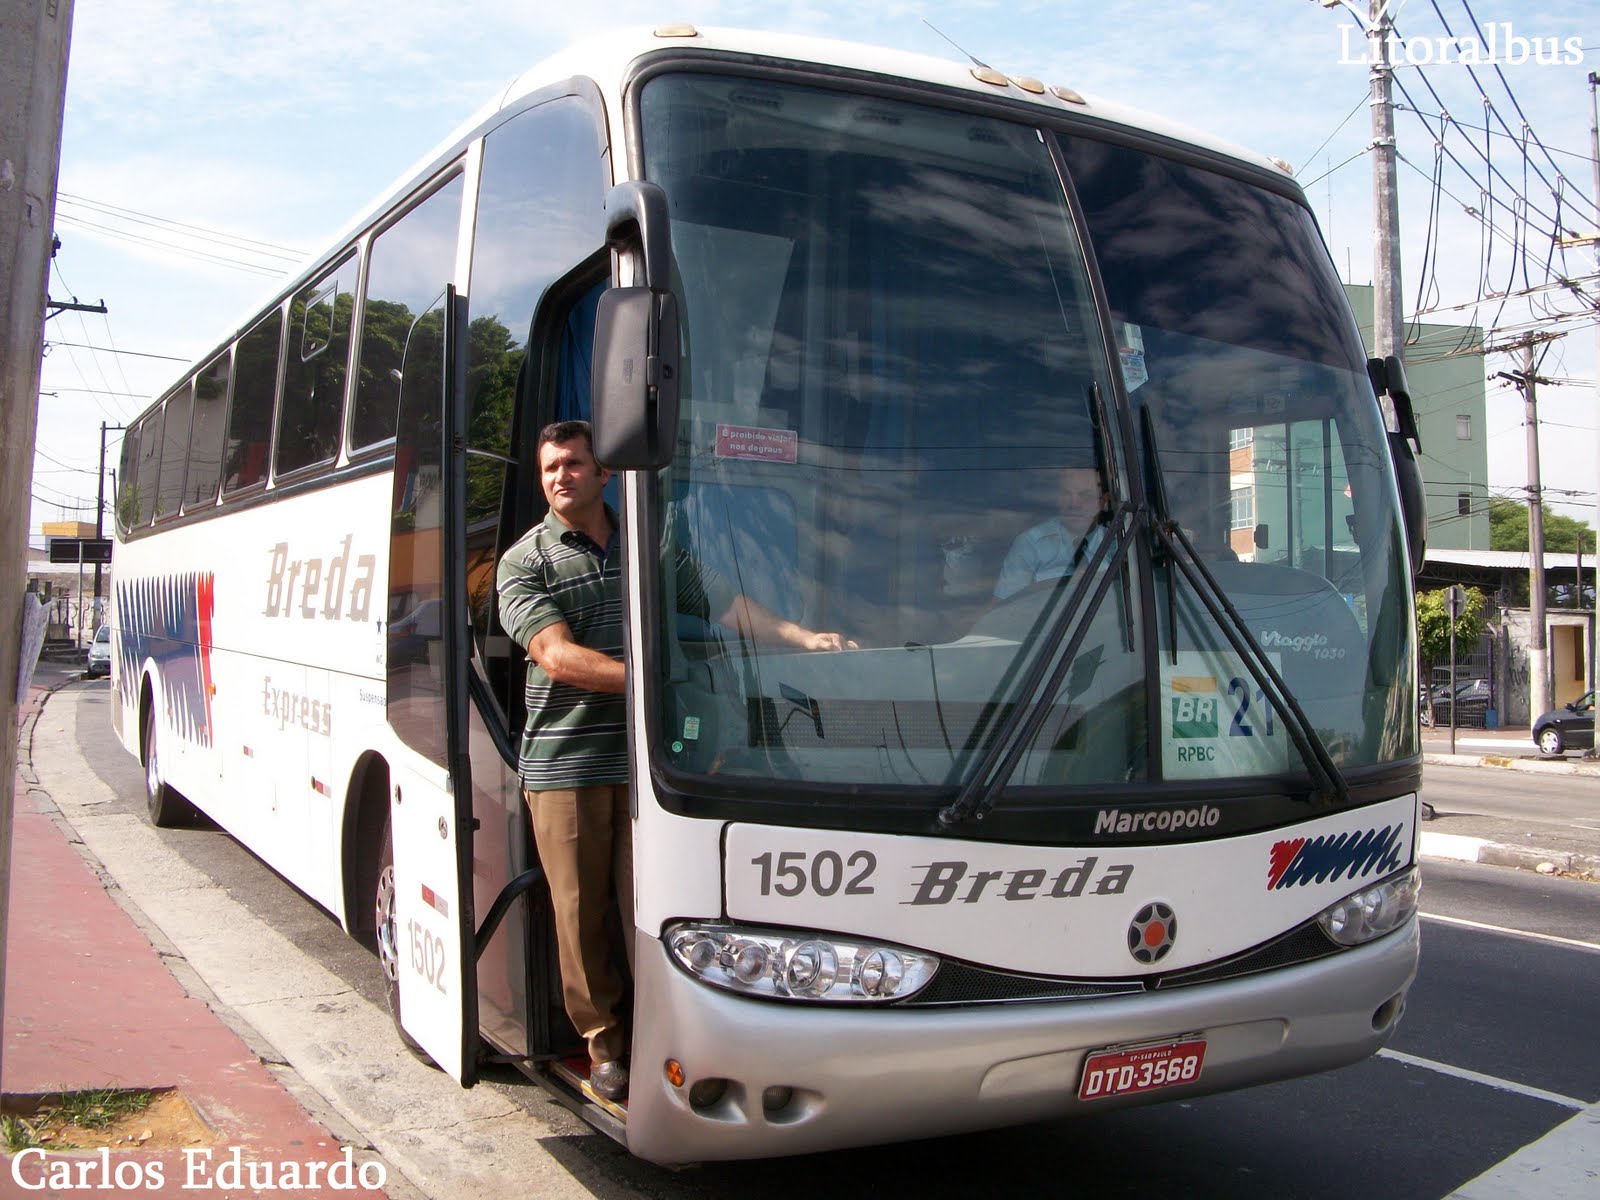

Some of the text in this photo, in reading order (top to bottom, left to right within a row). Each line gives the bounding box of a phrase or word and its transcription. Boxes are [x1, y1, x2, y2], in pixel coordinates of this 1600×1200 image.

[729, 442, 783, 454] nos degraus
[730, 431, 766, 441] proibido
[768, 433, 793, 444] viajar
[261, 533, 377, 622] Breda
[1260, 630, 1328, 652] Viaggio
[261, 675, 332, 737] Express
[1176, 697, 1214, 723] BR
[1228, 677, 1274, 736] 21
[1177, 745, 1216, 762] RPBC
[1093, 804, 1221, 835] Marcopolo
[751, 849, 878, 898] 1502
[899, 856, 1135, 906] Breda
[407, 917, 448, 995] 1502
